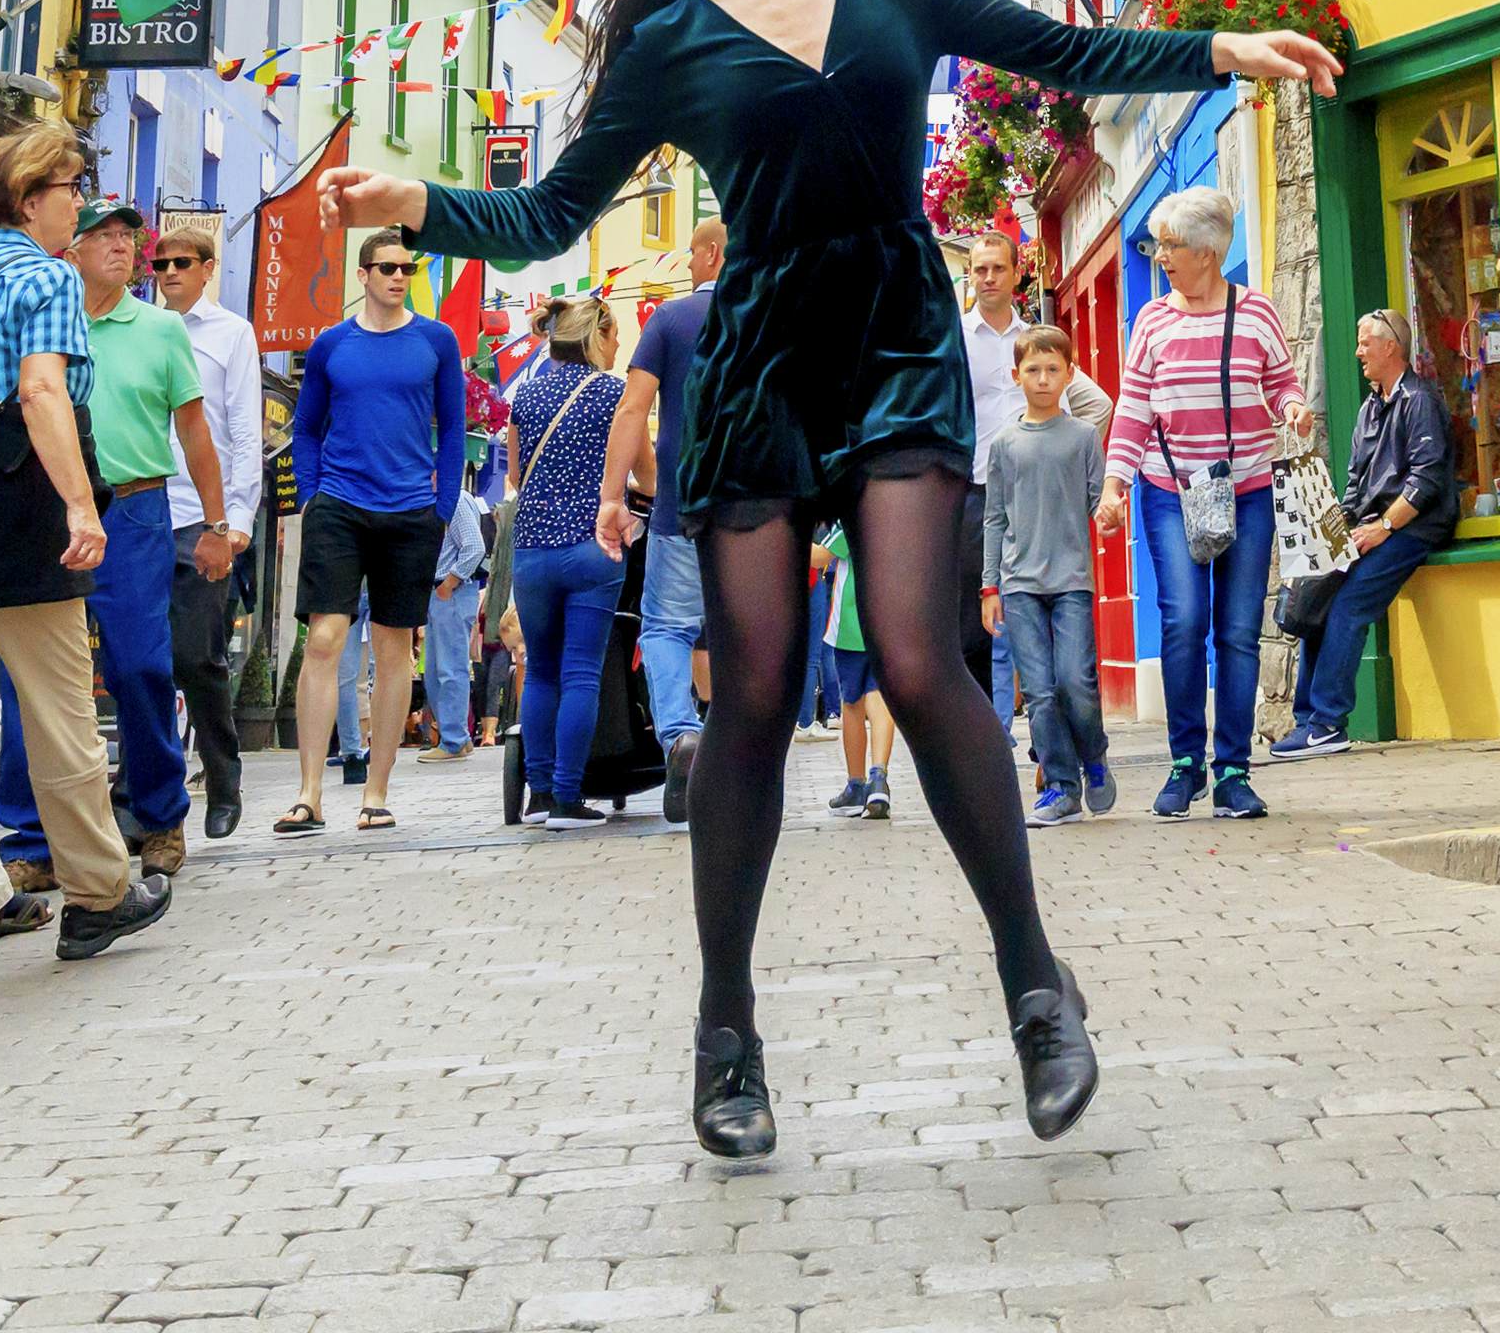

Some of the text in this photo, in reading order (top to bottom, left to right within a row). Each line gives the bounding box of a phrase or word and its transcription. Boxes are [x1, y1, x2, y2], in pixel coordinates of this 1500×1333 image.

[89, 21, 198, 45] BISTRO
[164, 215, 221, 235] MOLONEY
[266, 215, 284, 322] MOLONEY
